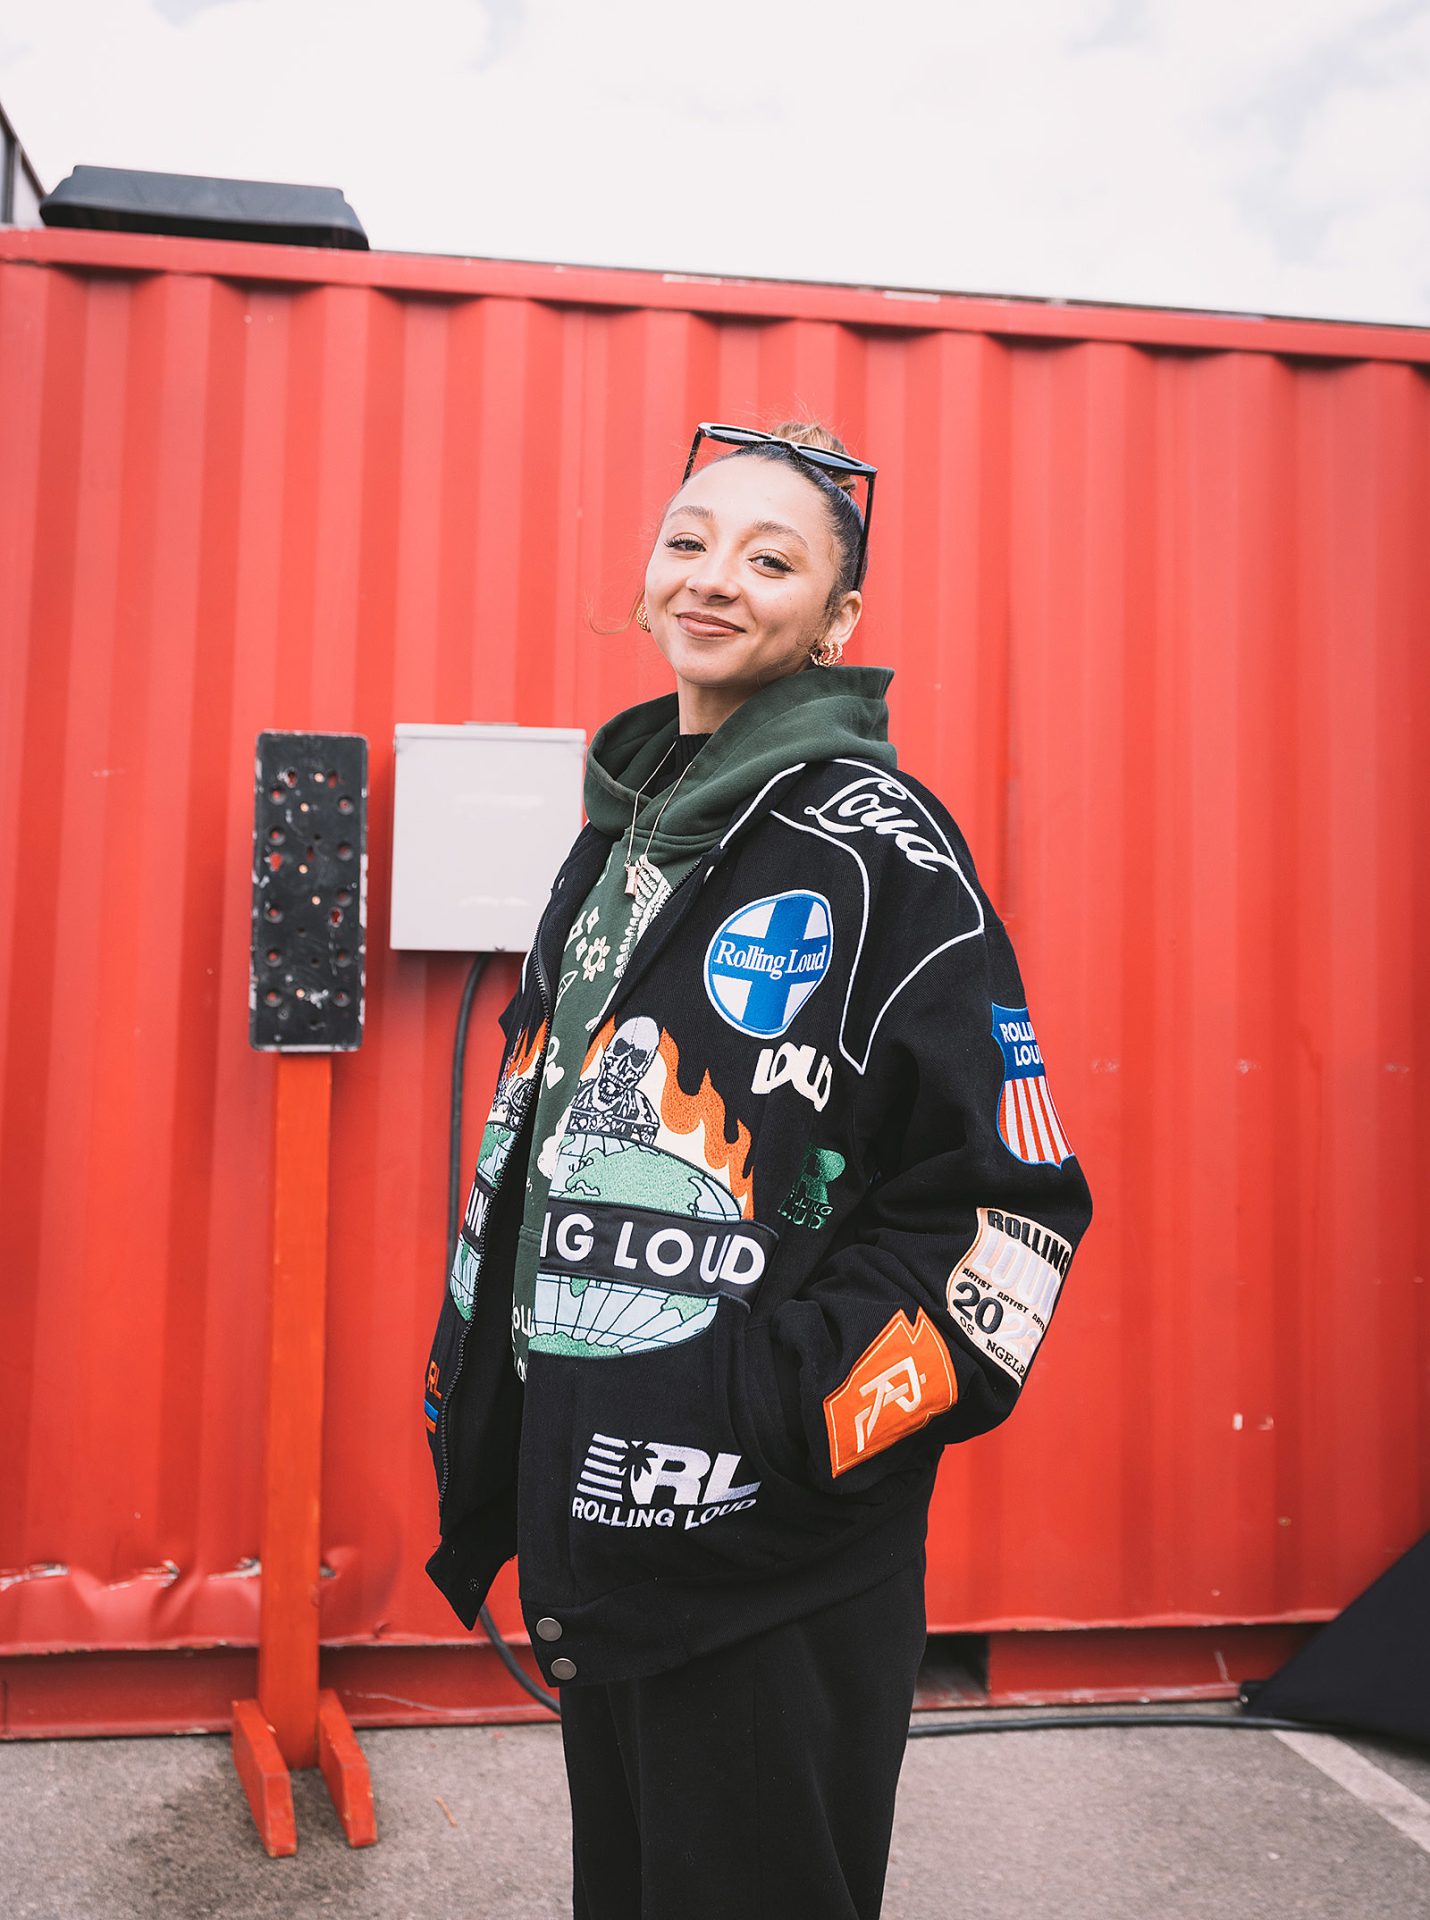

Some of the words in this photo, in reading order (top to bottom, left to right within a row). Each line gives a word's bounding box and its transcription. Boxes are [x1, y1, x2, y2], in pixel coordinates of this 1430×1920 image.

[803, 776, 958, 873] Loud
[713, 939, 786, 980] Rolling
[785, 945, 828, 974] Loud
[1013, 1044, 1045, 1067] LOU
[613, 1220, 767, 1286] LOUD
[962, 1267, 993, 1291] ARTIST
[996, 1291, 1029, 1314] ARTIST
[629, 1441, 762, 1506] RL
[571, 1496, 676, 1529] ROLLING
[683, 1498, 757, 1531] LOUD
